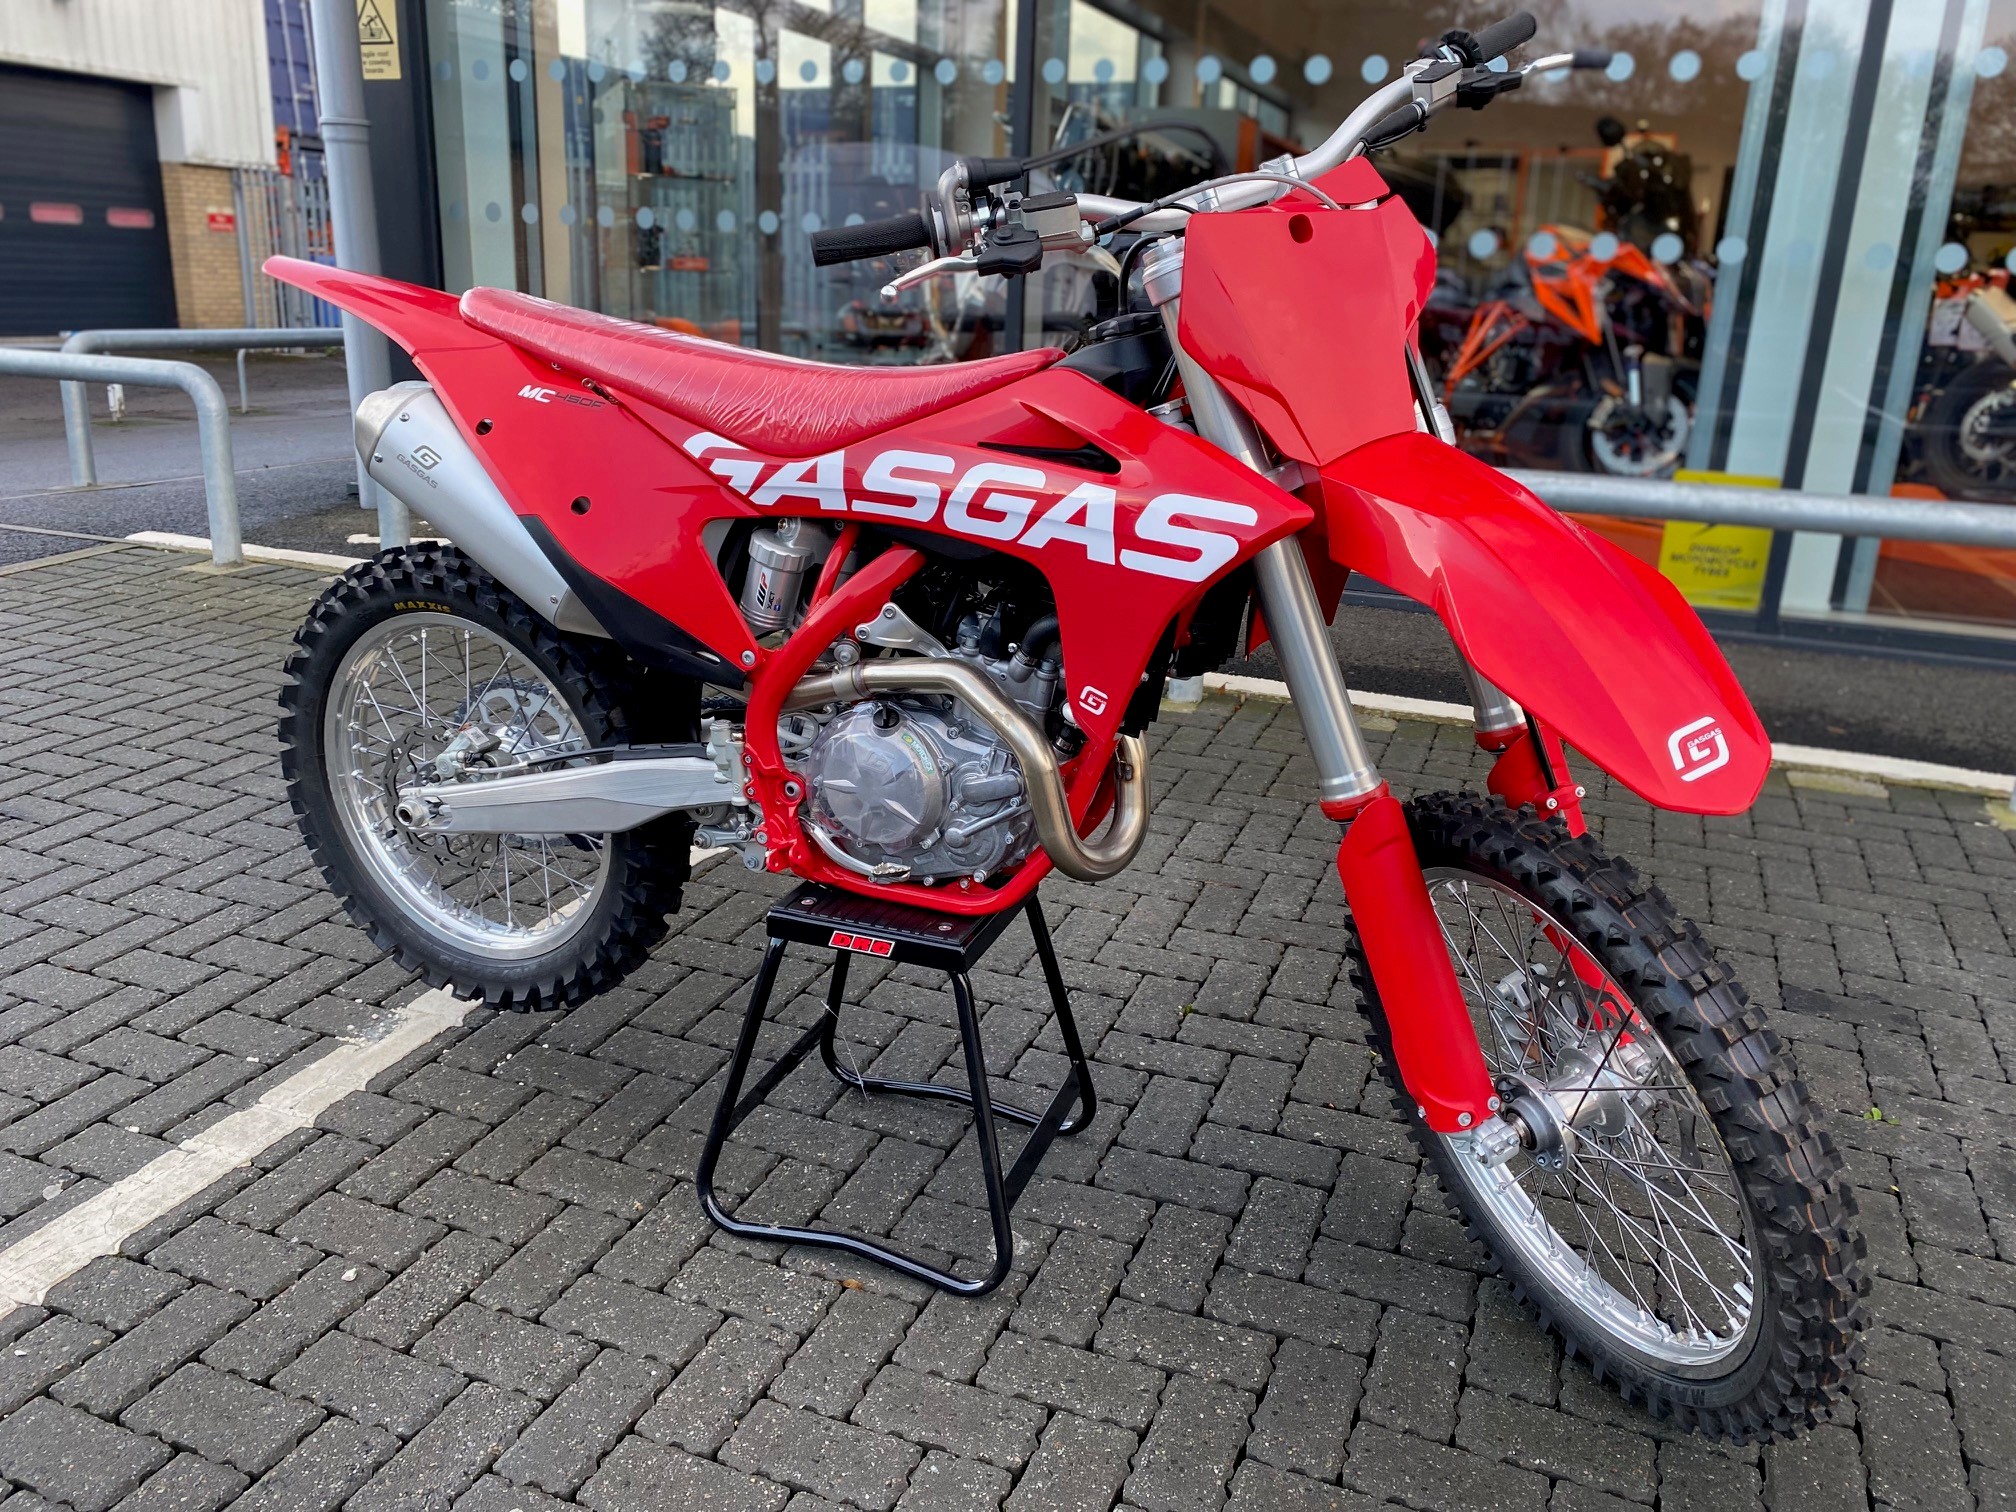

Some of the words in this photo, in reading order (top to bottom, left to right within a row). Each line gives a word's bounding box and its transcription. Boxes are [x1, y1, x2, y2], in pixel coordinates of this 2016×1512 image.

[396, 453, 438, 488] GASGAS
[682, 431, 1258, 583] GASGAS
[1687, 727, 1721, 748] GASGAS
[830, 932, 892, 955] DRC
